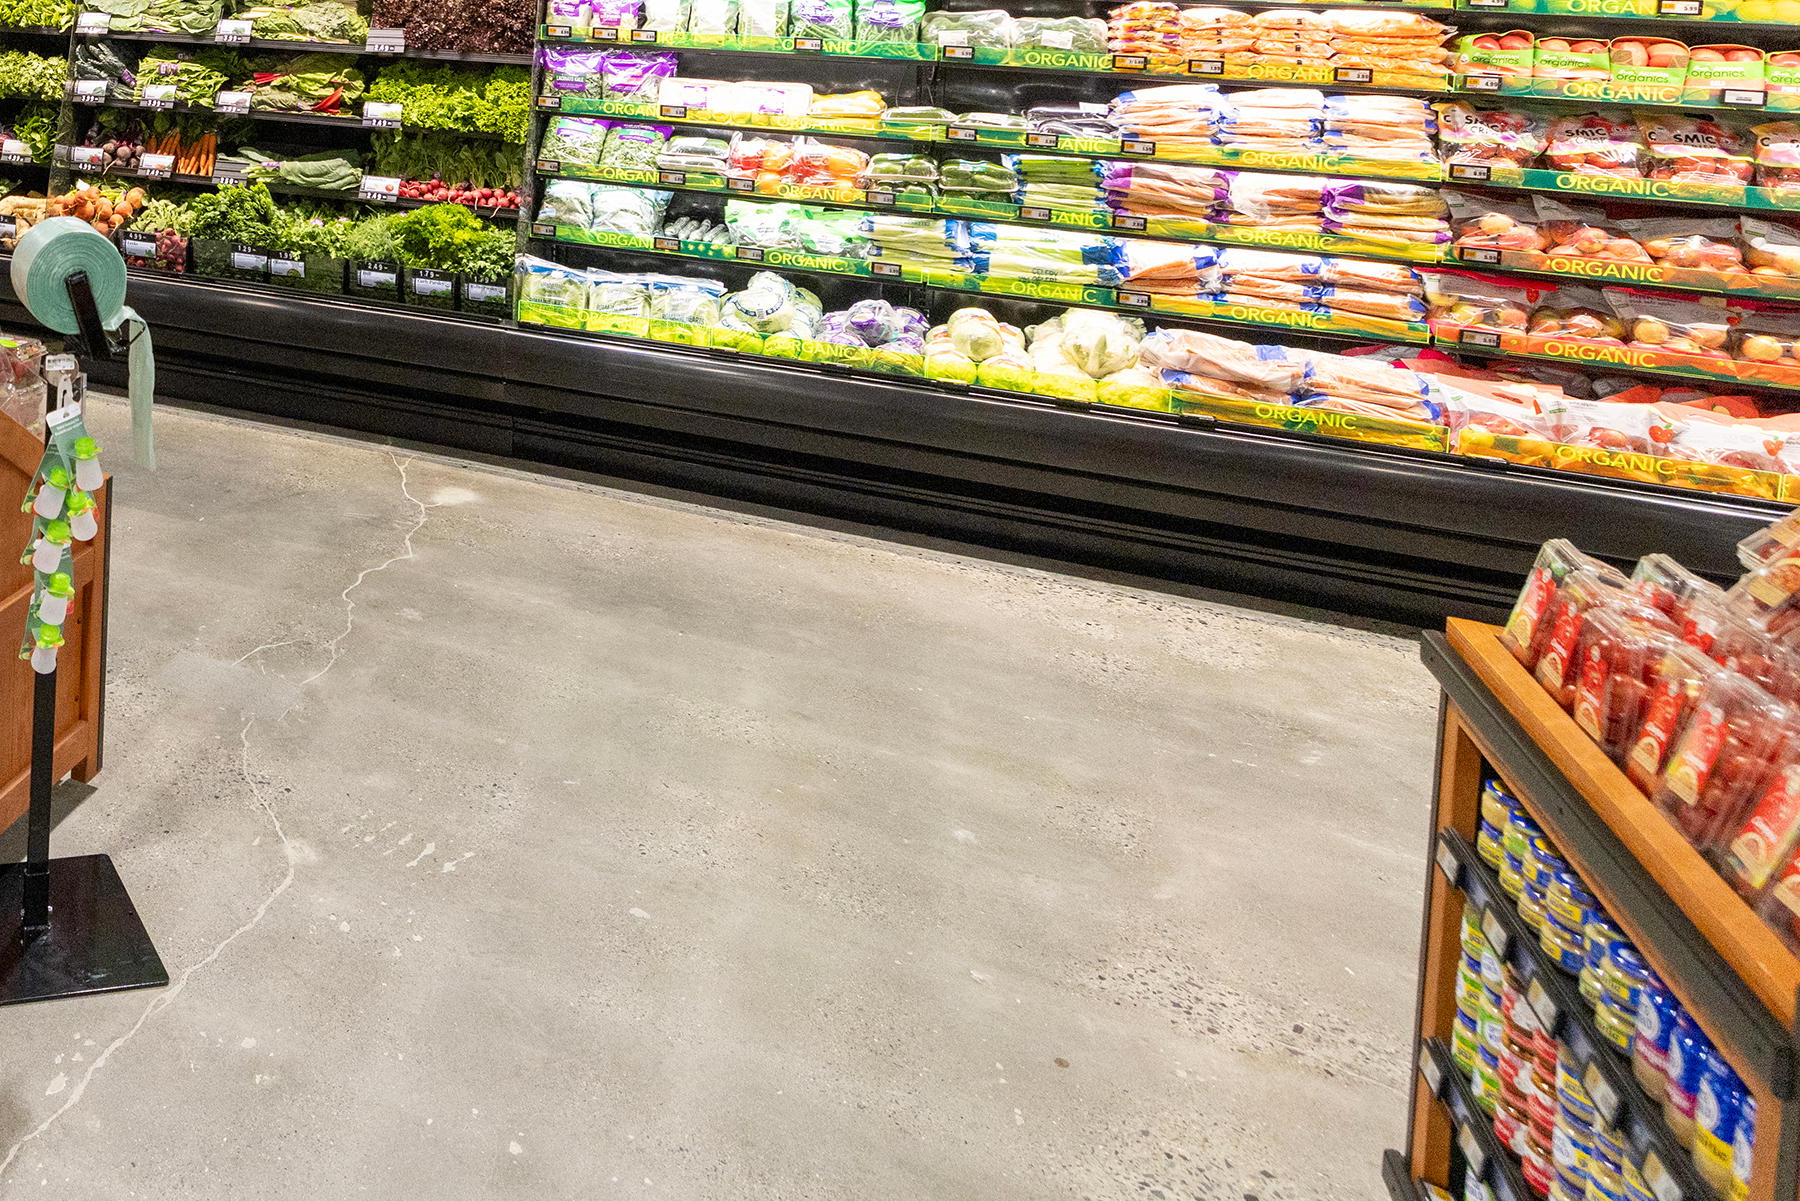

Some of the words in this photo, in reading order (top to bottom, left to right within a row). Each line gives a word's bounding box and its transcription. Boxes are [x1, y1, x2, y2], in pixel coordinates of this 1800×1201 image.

[1024, 50, 1114, 69] ORGANIC
[1471, 54, 1520, 65] organics
[1540, 57, 1590, 69] organics
[1615, 72, 1670, 84] organics
[1690, 67, 1745, 79] organics
[1562, 81, 1678, 104] ORGANIC
[1241, 149, 1340, 172] ORGANIC
[776, 183, 854, 203] ORGANIC
[1556, 173, 1670, 198] ORGANIC
[1237, 226, 1333, 251] ORGANIC
[768, 251, 846, 271] ORGANIC
[1550, 257, 1664, 283] ORGANIC
[1009, 281, 1098, 303] ORGANIC
[1230, 304, 1329, 330] ORGANIC
[1543, 341, 1657, 368] ORGANIC
[1255, 403, 1358, 430] ORGANIC
[1555, 445, 1676, 476] ORGANIC
